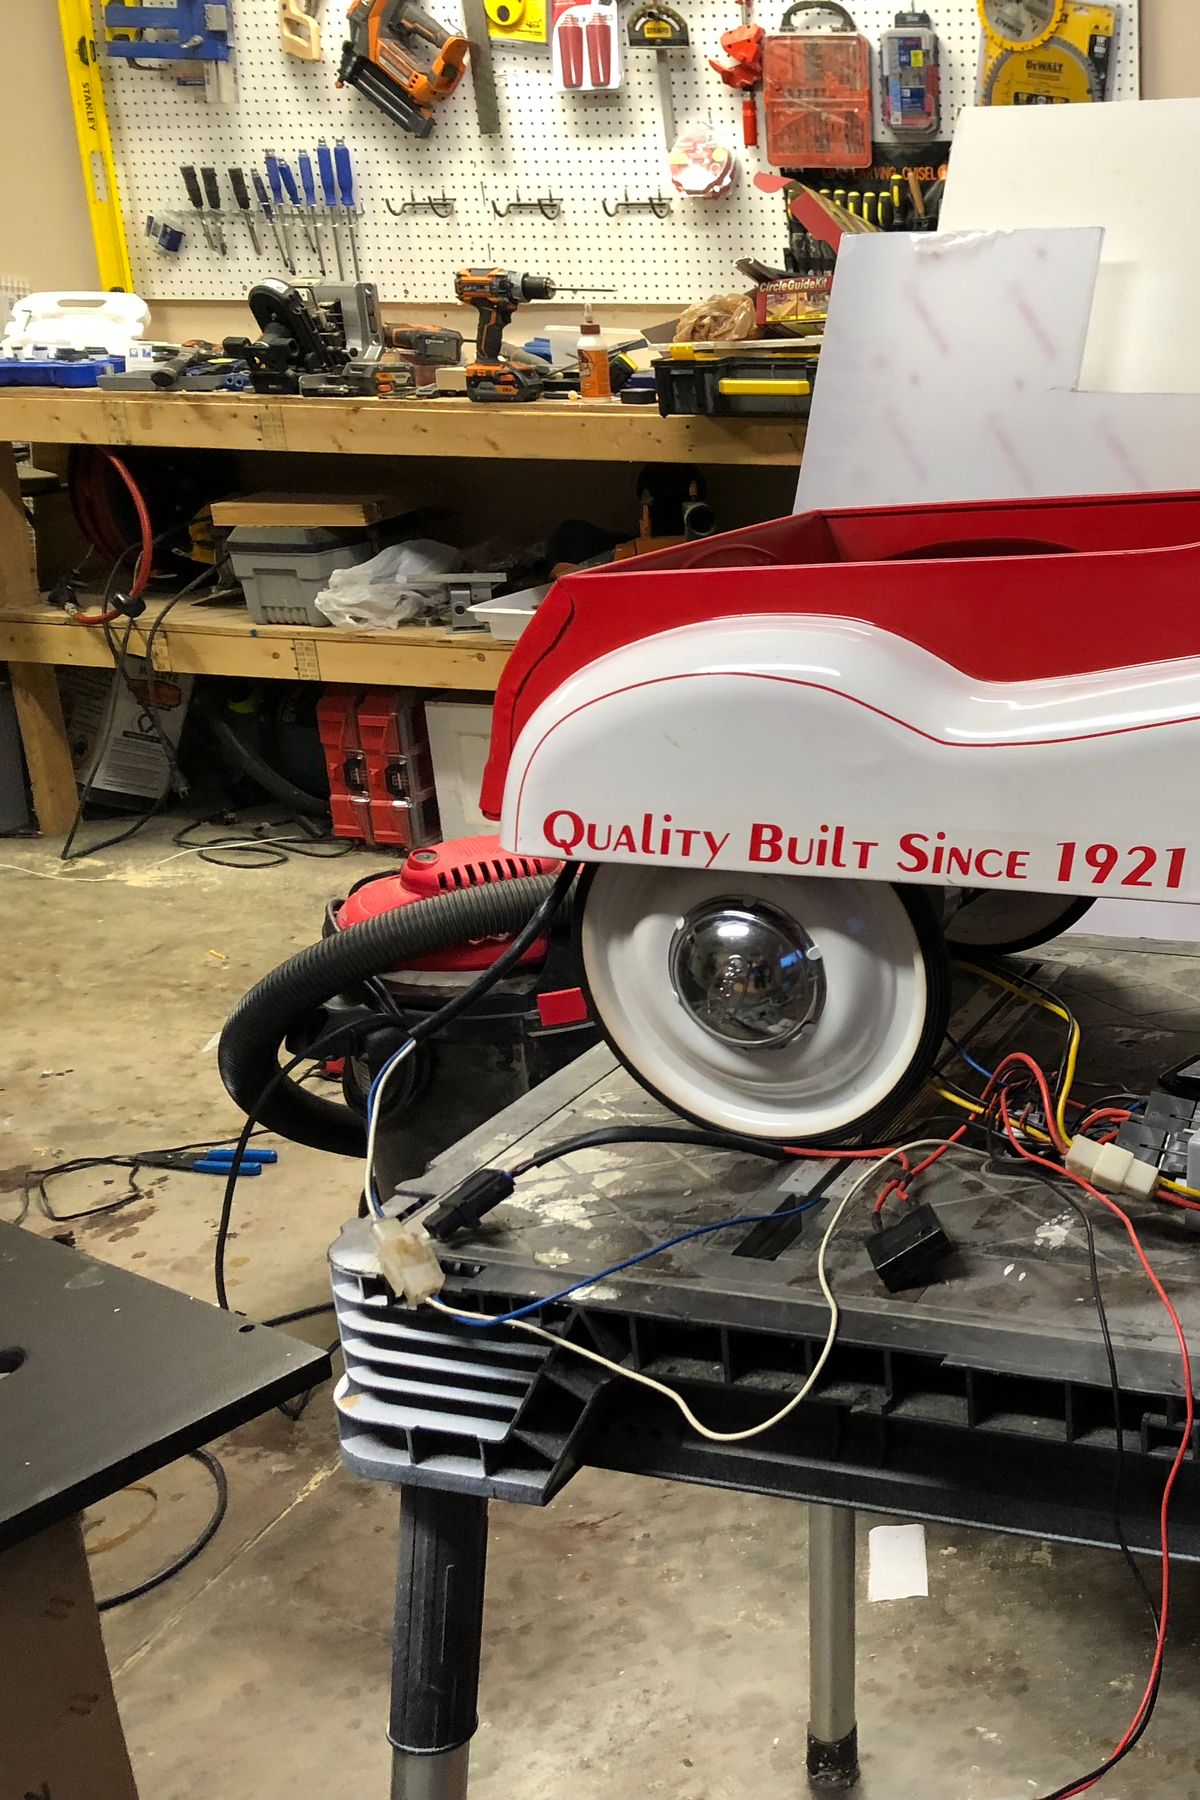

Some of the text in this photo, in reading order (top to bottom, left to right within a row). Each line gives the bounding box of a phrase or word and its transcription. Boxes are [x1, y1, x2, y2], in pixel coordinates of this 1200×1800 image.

[82, 82, 97, 131] STANLEY
[542, 809, 1186, 888] Quality Built Since 1921
